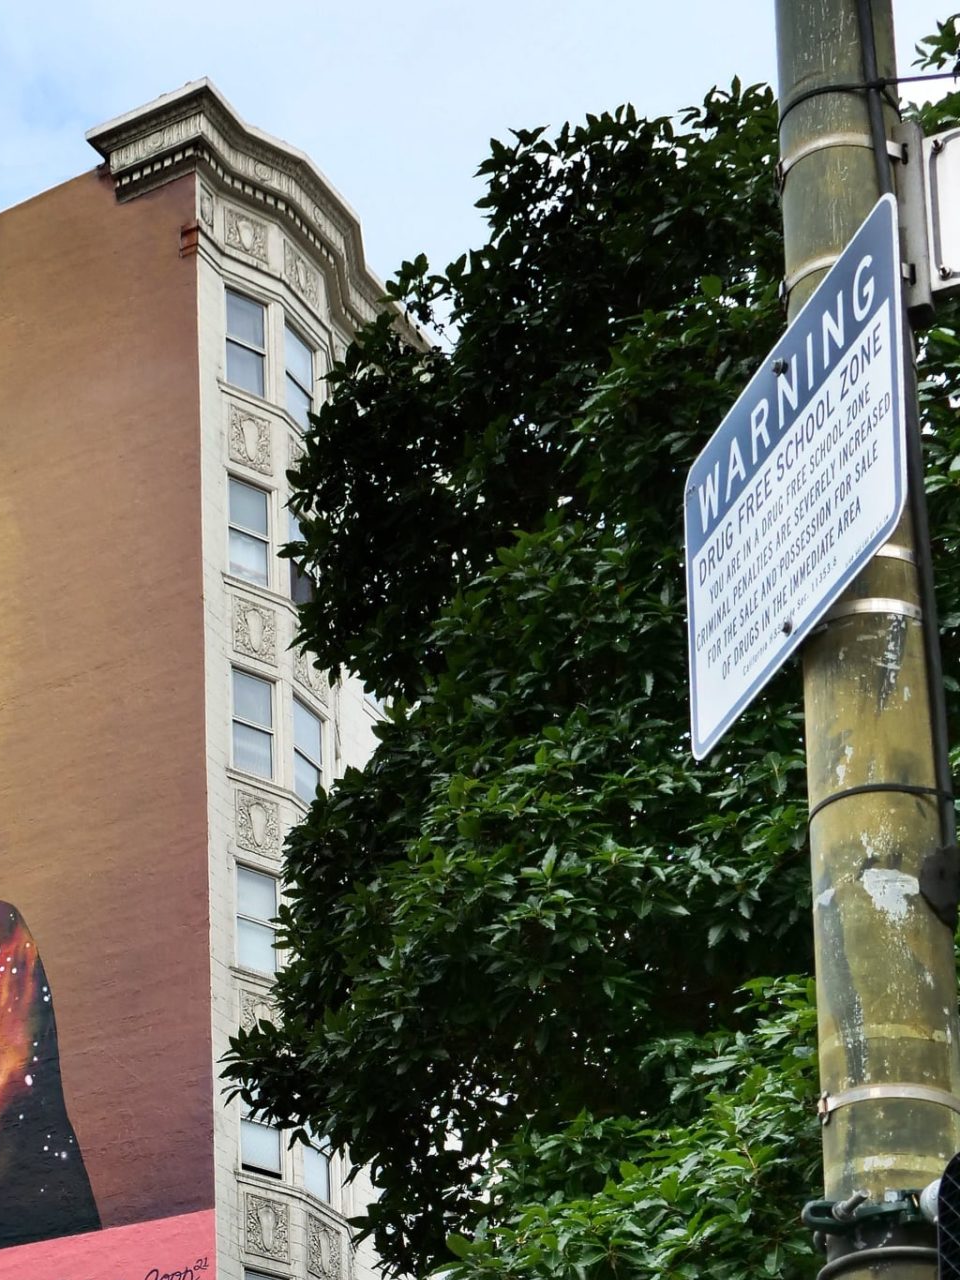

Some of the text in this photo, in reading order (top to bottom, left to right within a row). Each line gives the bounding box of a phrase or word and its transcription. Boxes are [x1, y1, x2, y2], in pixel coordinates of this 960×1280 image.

[698, 254, 875, 534] WARNING
[699, 320, 882, 587] DRUG FREE SCHOOL ZONE
[709, 380, 870, 605] YOU ARE IN A DRUG FREE SCHOOL ZONE
[697, 594, 730, 652] CRIMINAL
[733, 538, 773, 605] PENALTIES
[775, 514, 791, 551] ARE
[794, 458, 835, 526] SEVERELY
[839, 388, 890, 470] INCREASED
[707, 438, 878, 669] FOR THE SALE AND POSSESSION FOR SALE
[722, 493, 861, 681] OF DRUGS IN THE IMMEDIATE AREA
